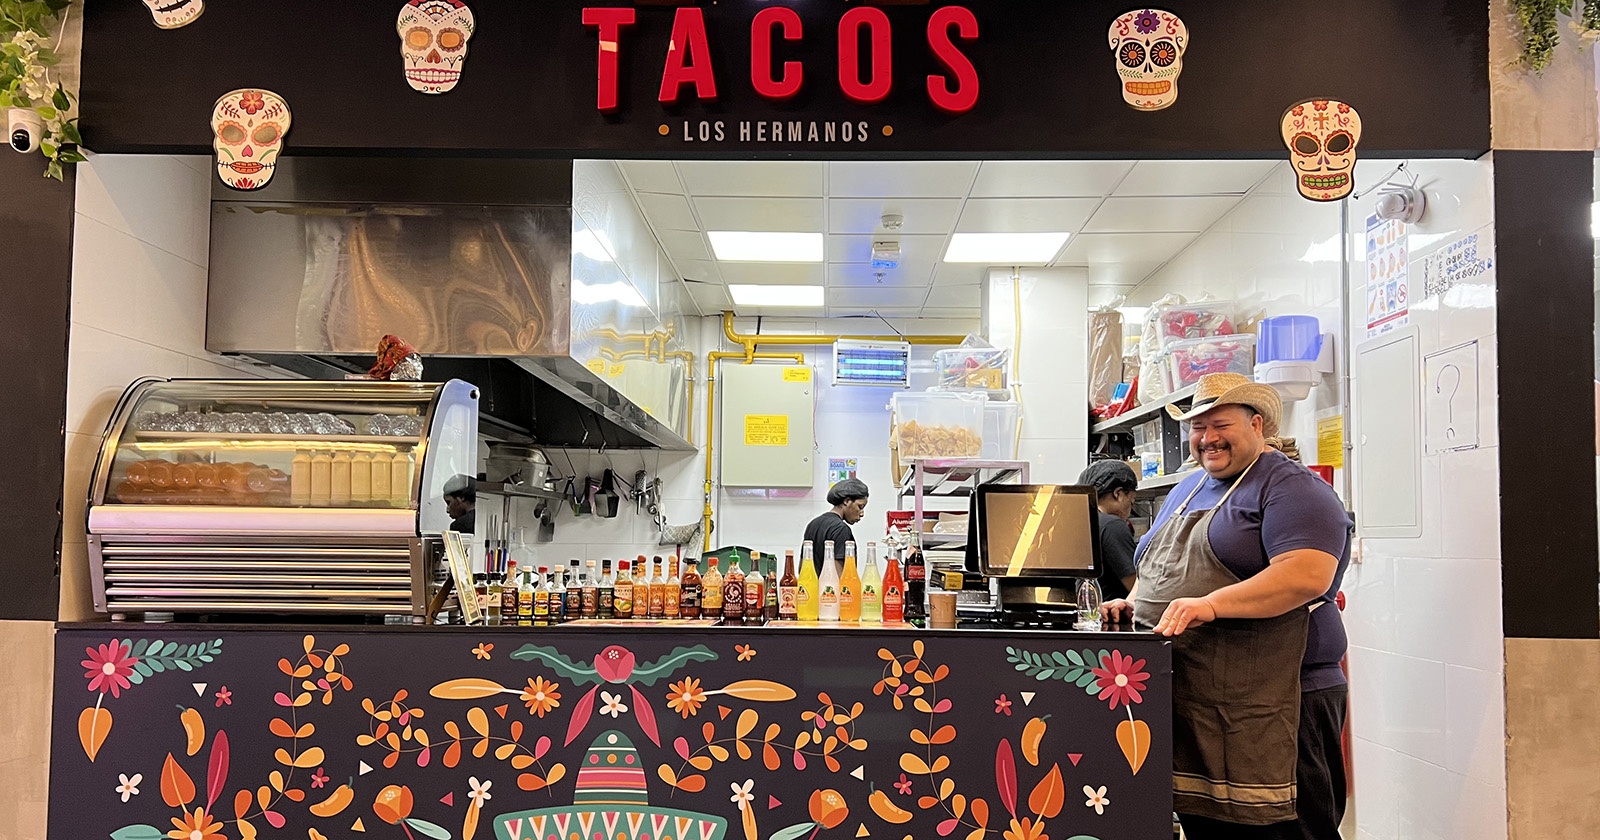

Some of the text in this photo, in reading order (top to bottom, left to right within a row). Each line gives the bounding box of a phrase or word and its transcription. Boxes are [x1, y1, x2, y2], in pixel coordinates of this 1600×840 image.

[581, 5, 980, 112] TACOS
[684, 120, 868, 142] LOS HERMANOS
